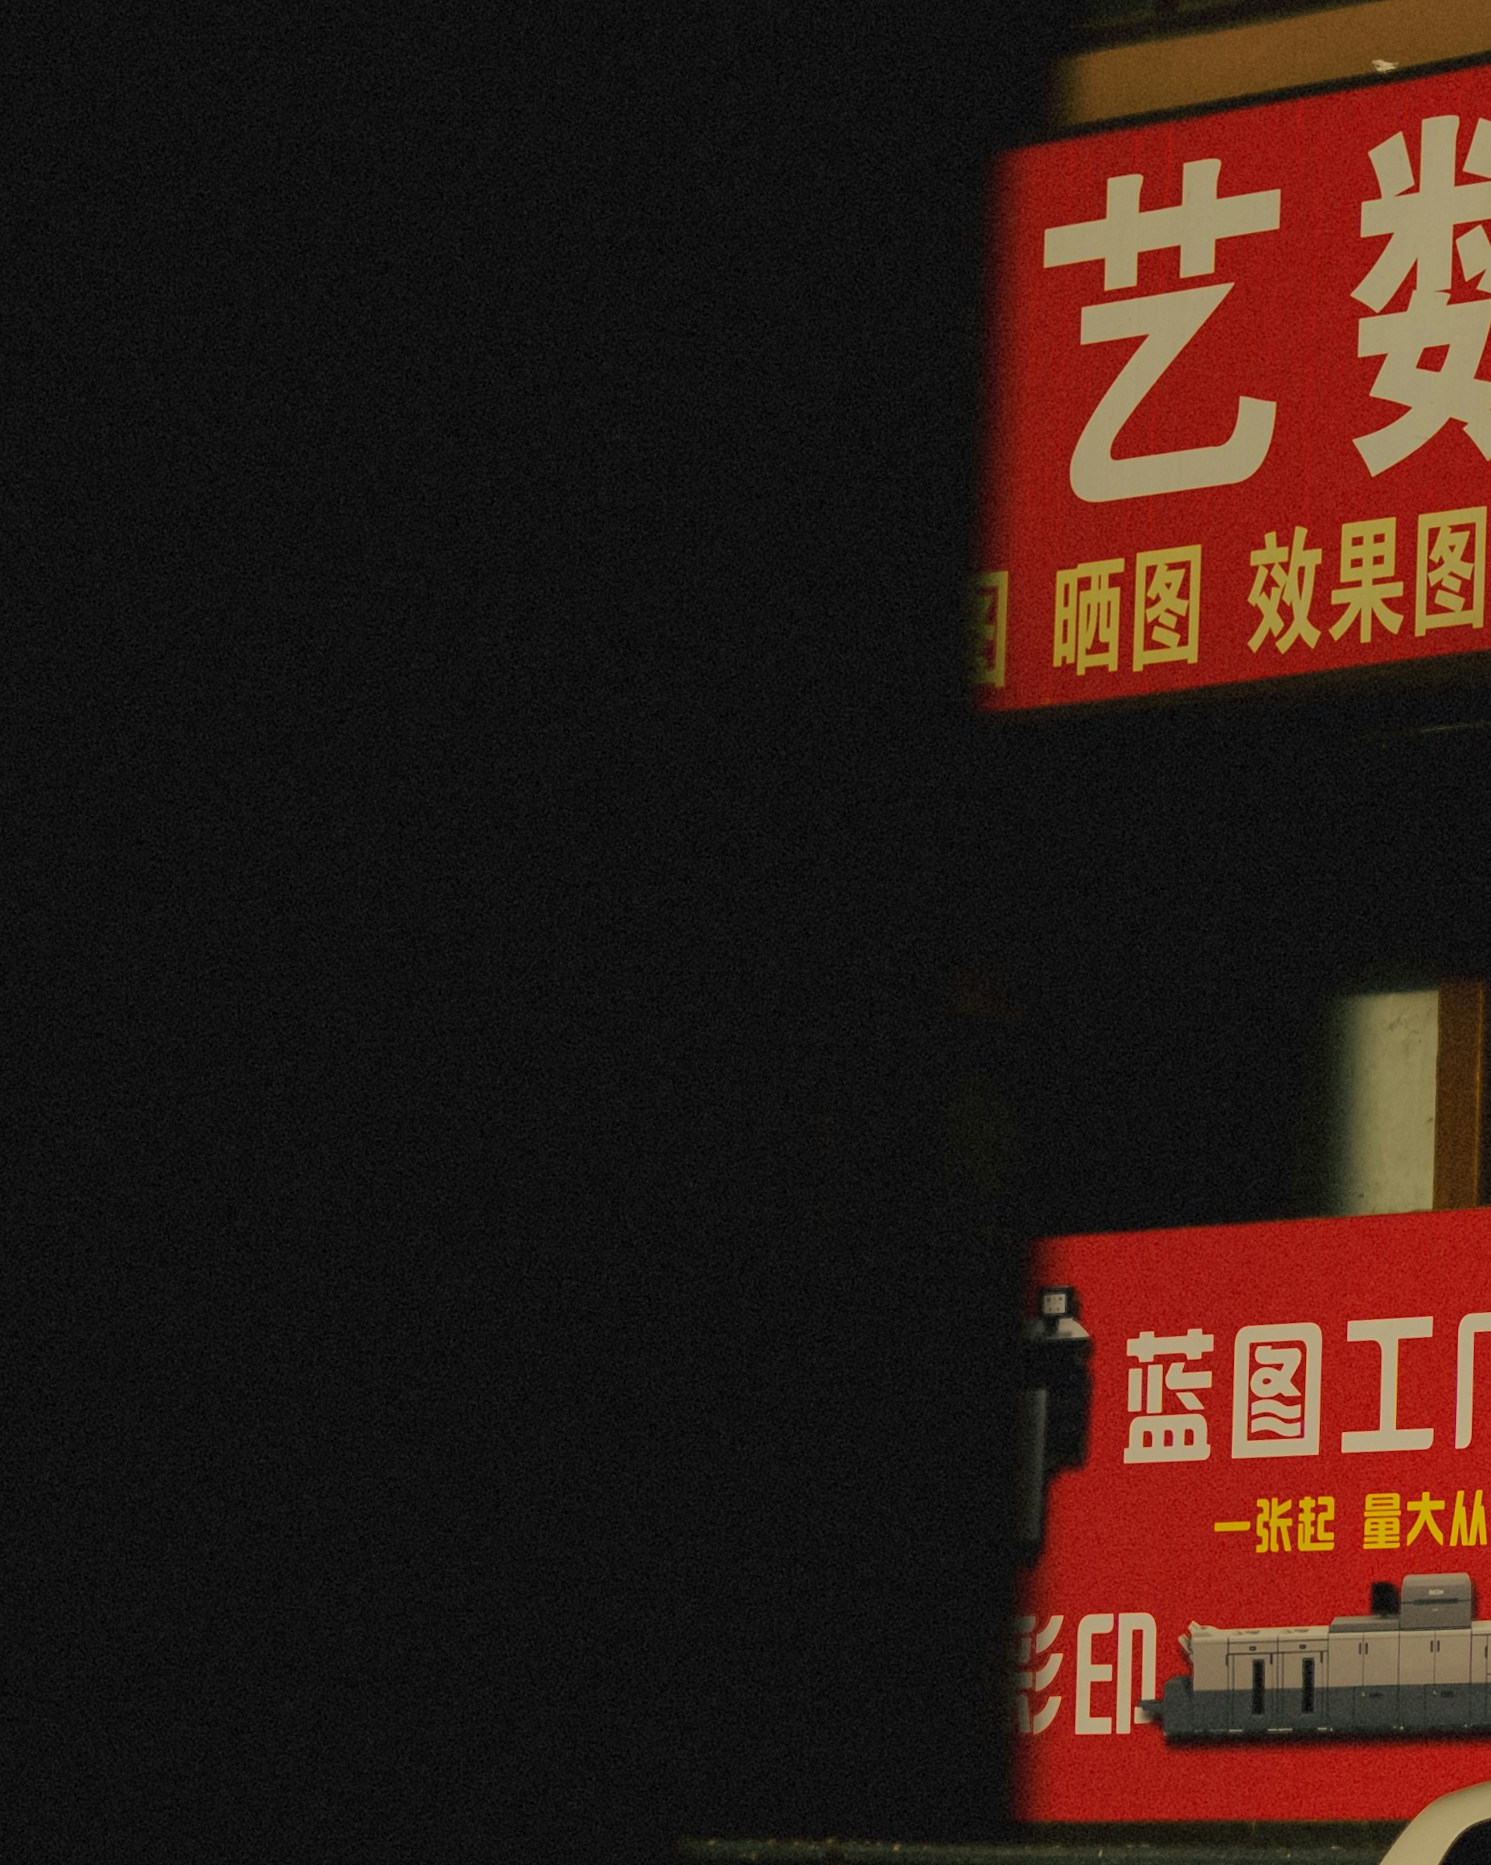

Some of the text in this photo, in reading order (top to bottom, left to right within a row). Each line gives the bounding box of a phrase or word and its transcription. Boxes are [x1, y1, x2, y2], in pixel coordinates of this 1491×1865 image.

[1052, 544, 1202, 676] 晒图
[1247, 506, 1488, 654] 效果图
[1214, 1495, 1336, 1553] 一张起
